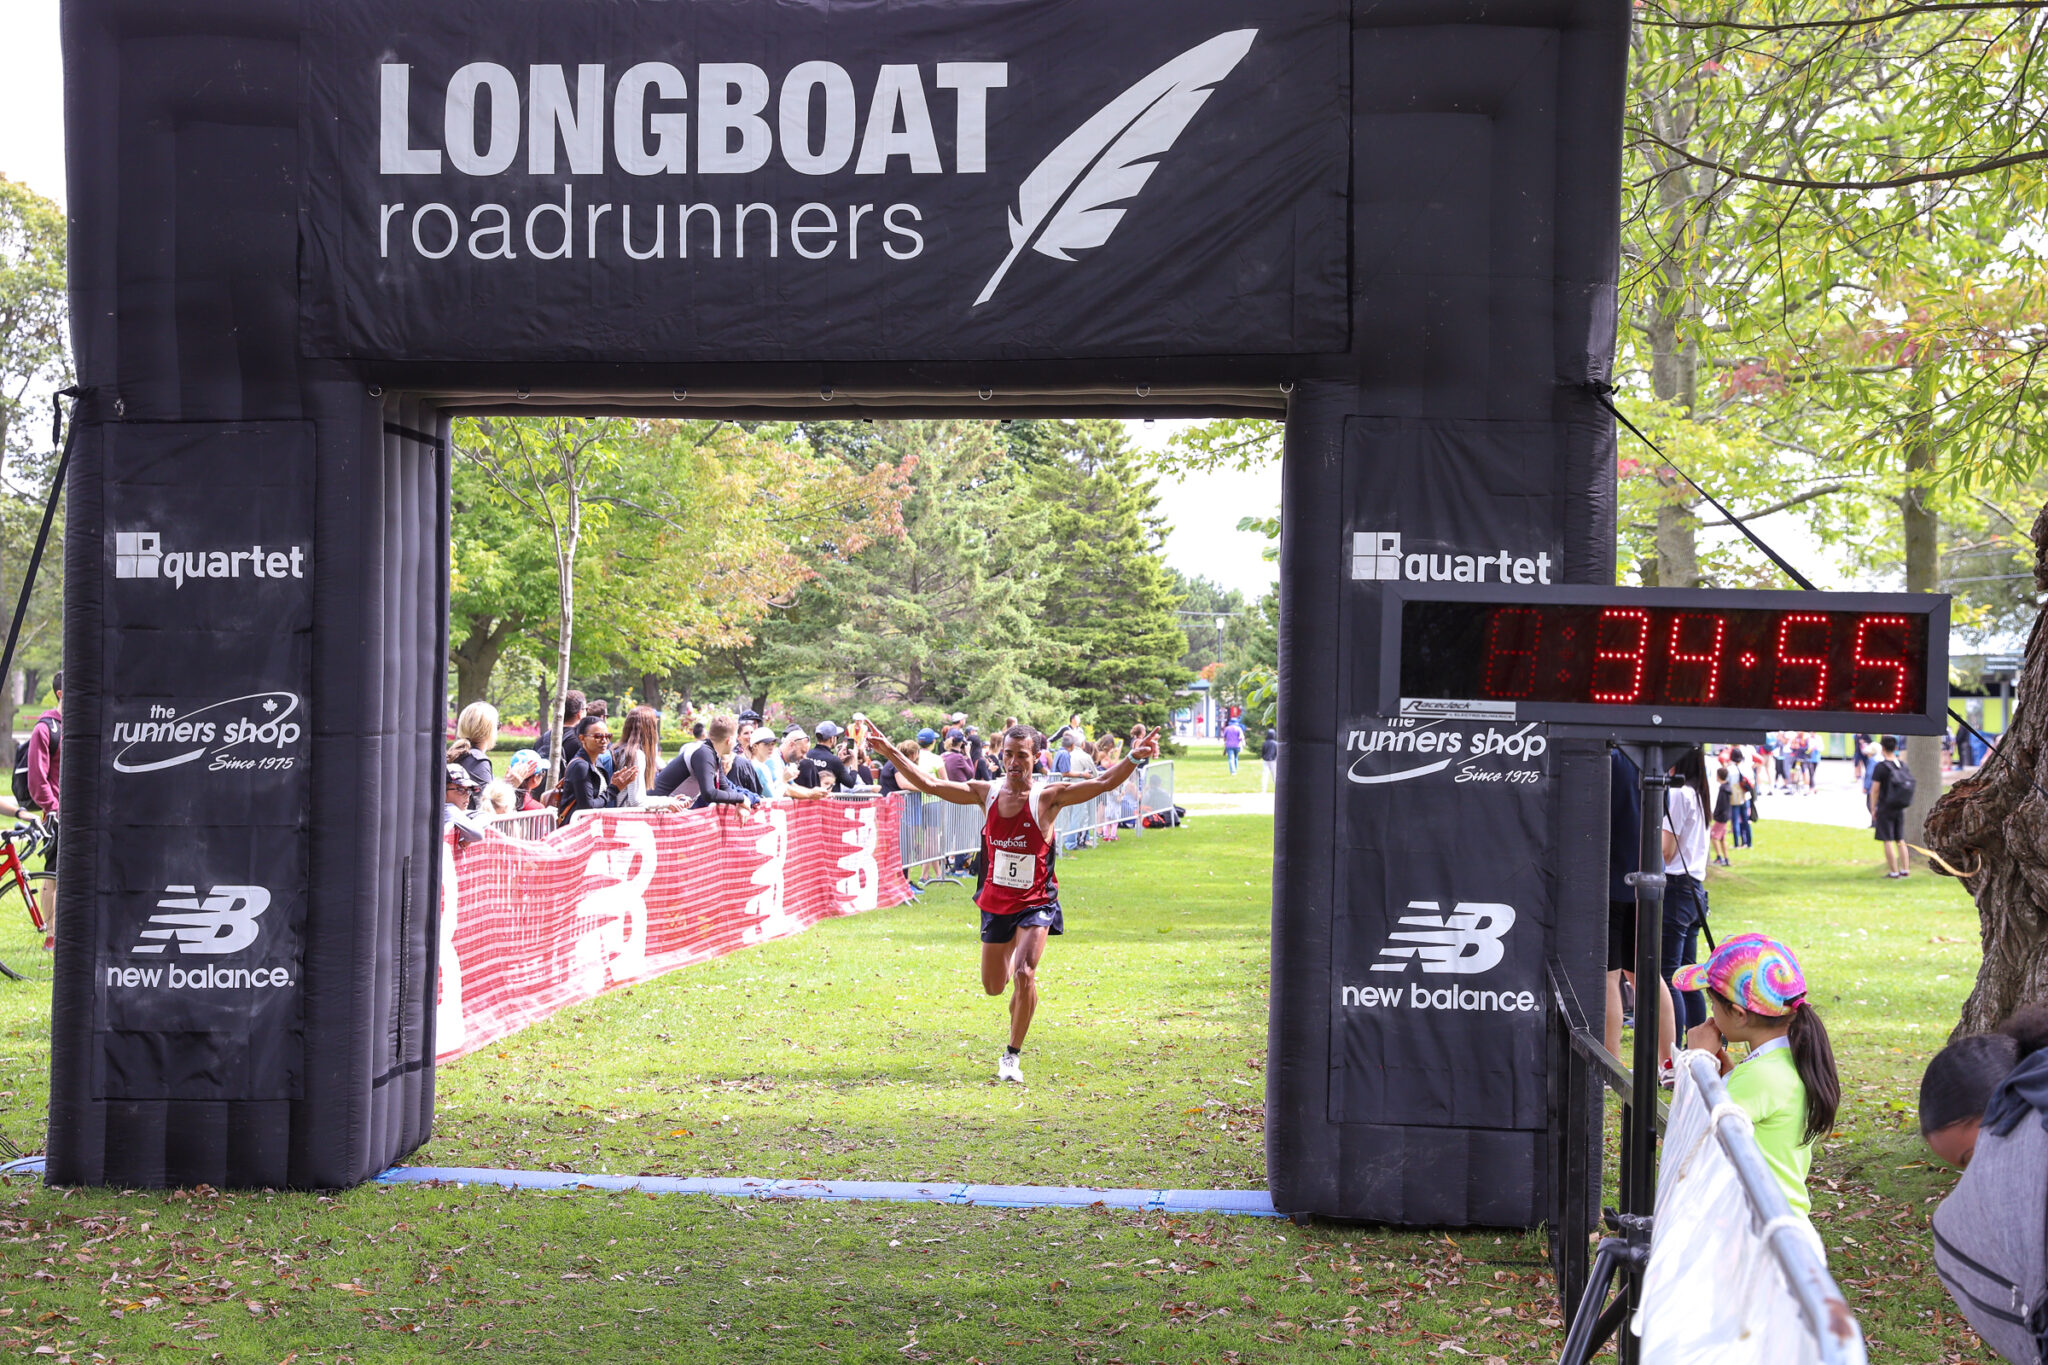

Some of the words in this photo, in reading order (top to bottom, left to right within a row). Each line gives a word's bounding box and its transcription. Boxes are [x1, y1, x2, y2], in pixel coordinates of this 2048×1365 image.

[379, 60, 1008, 177] LONGBOAT
[380, 184, 924, 261] roadrunners
[163, 545, 304, 590] quartet
[1404, 549, 1552, 584] quartet
[150, 704, 176, 719] the
[113, 721, 217, 743] runners
[222, 716, 301, 749] shop
[1346, 729, 1463, 754] runners
[1469, 727, 1547, 762] shop
[208, 754, 257, 771] Since
[257, 756, 295, 771] 1975
[1454, 765, 1503, 783] Since
[1504, 769, 1540, 784] 1975
[989, 835, 1027, 848] Longboat
[1009, 862, 1017, 877] 5
[107, 966, 164, 988] new
[1342, 985, 1404, 1008] new
